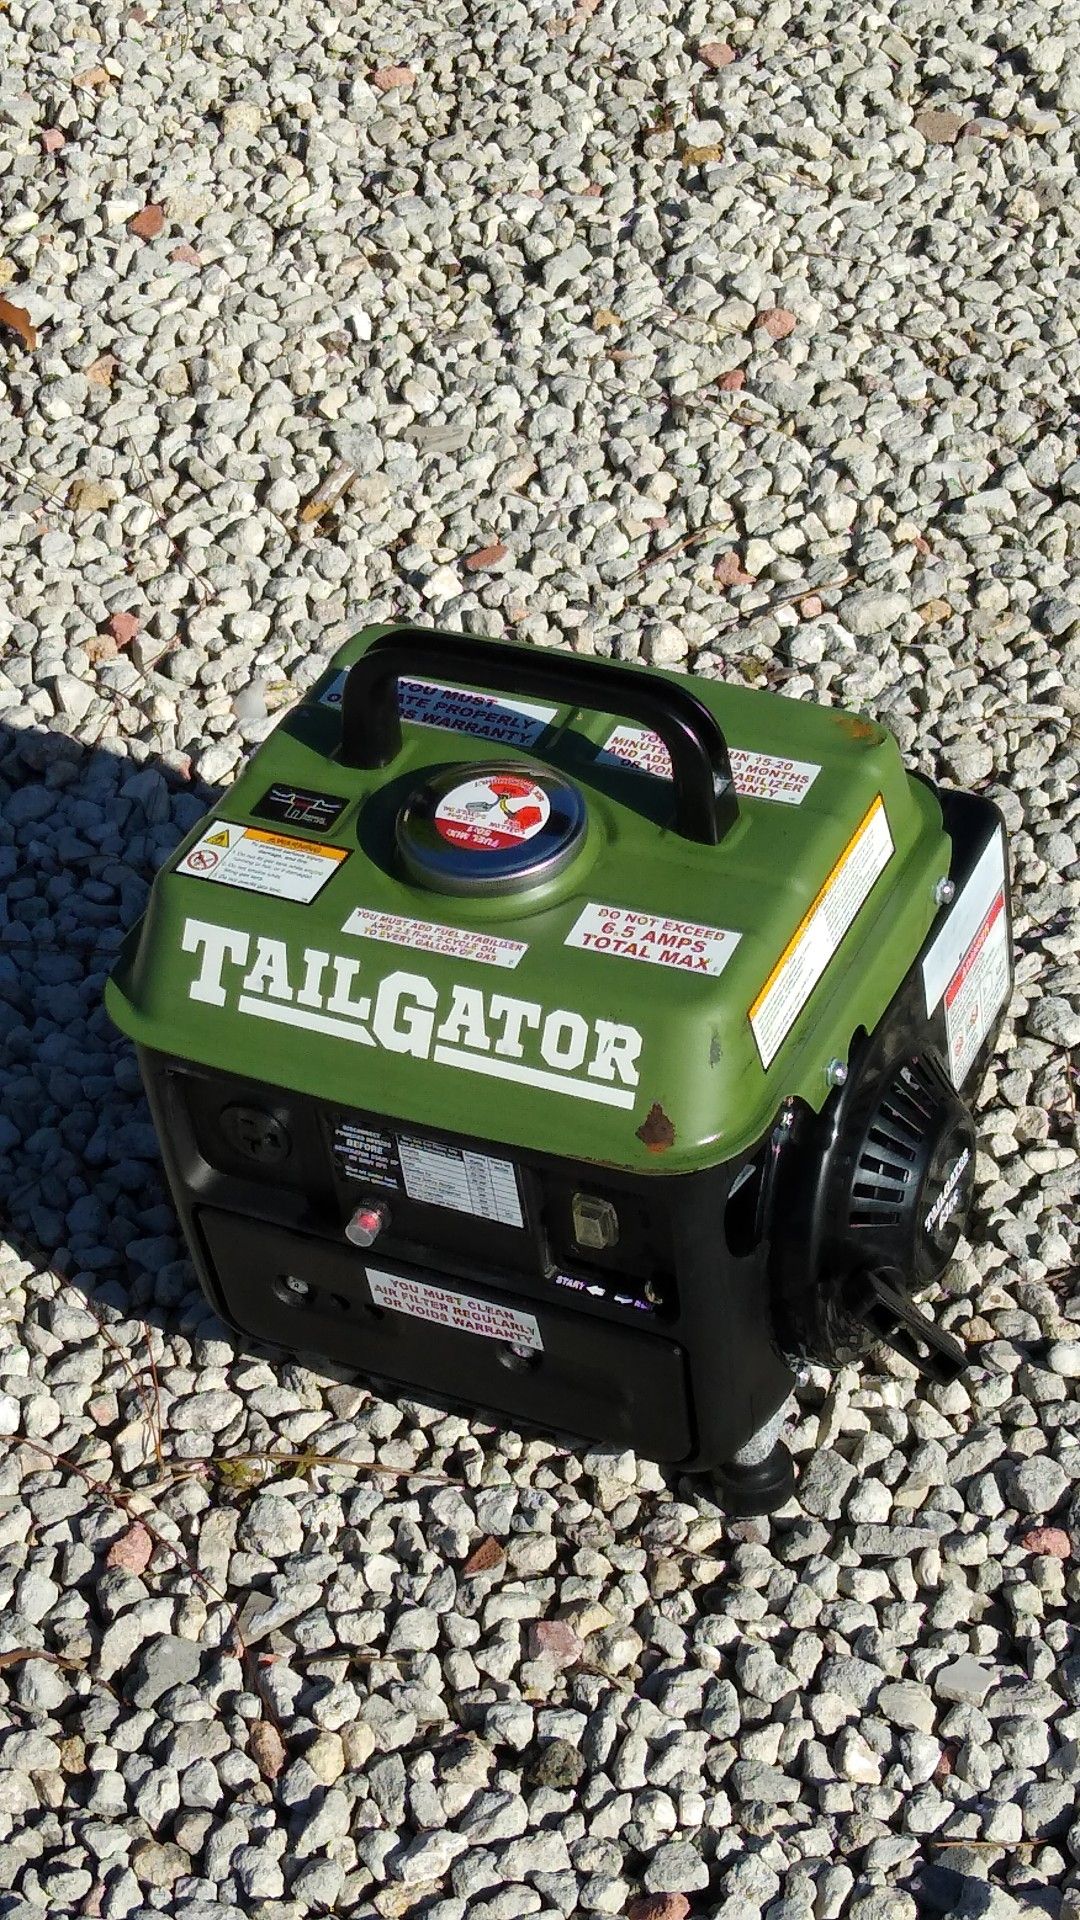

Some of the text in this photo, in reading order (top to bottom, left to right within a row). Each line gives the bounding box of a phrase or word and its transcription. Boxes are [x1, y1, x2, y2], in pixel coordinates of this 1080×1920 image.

[399, 680, 437, 695] YOU
[443, 690, 499, 706] MUST
[422, 711, 535, 743] WARRANTY
[434, 701, 536, 729] PROPERLY
[608, 745, 637, 759] AND
[641, 752, 671, 766] ADD
[620, 758, 641, 769] OR
[745, 766, 810, 785] MONTHS
[472, 836, 501, 849] FUEL
[357, 910, 524, 951] YOU MUST ADD FUEL STABILIZER
[371, 922, 393, 931] AND
[481, 945, 497, 954] OIL
[598, 908, 726, 942] DO NOT EXCEED
[601, 922, 708, 953] 6.5 AMPS
[364, 926, 496, 961] TO EVERY GALLON OF GAS
[582, 933, 712, 971] TOTAL MAX
[181, 918, 643, 1087] TAILGATOR
[346, 1138, 383, 1155] BEFORE
[556, 1274, 585, 1291] START
[375, 1284, 535, 1336] AIR FILTER REGULARLY
[390, 1279, 515, 1320] YOU MUST CLEAN
[383, 1297, 533, 1344] OR VOIDS WARRANTY
